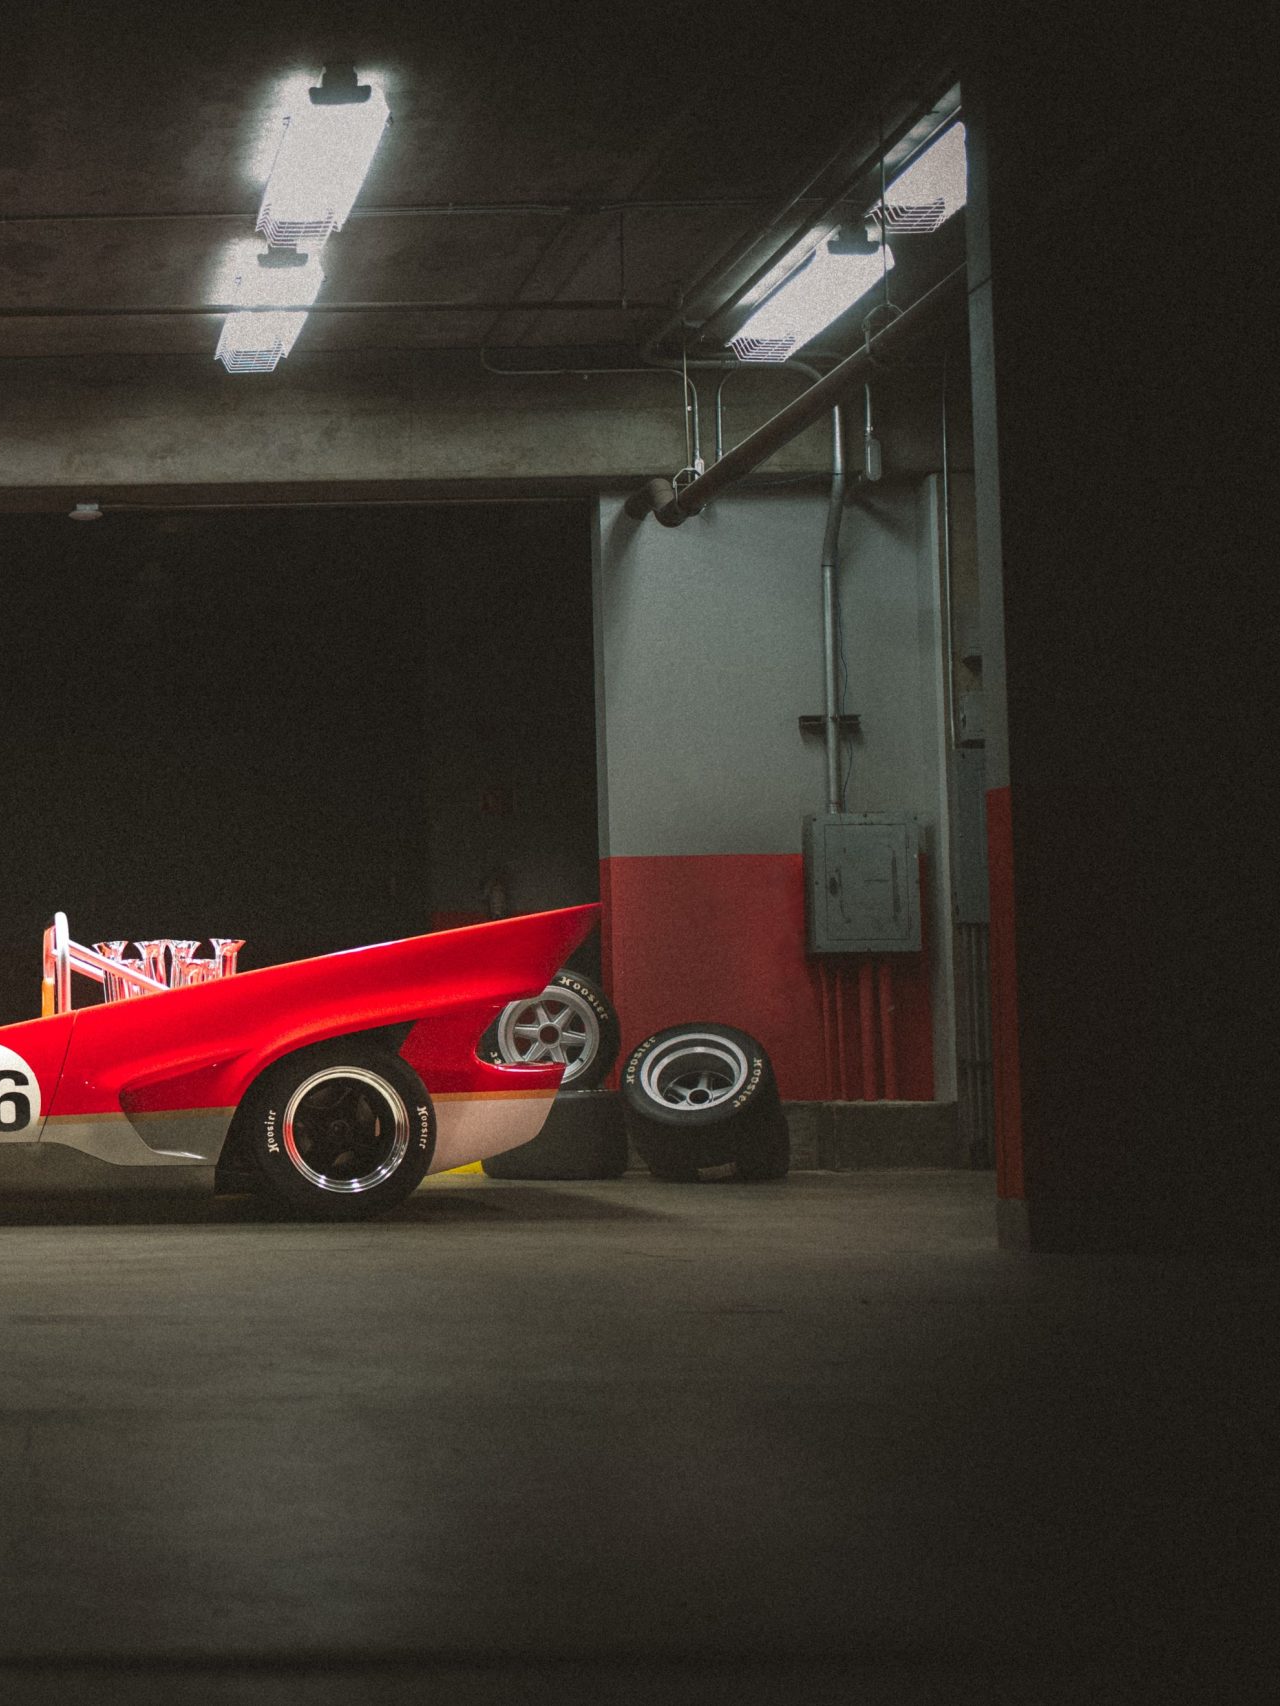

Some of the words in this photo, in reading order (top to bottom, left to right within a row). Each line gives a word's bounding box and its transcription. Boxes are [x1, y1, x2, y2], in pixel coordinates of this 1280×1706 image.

[558, 976, 608, 1020] Hoosier
[626, 1036, 656, 1084] Hoosier
[732, 1057, 762, 1107] Hoosier
[264, 1110, 280, 1152] Hoosier
[417, 1106, 428, 1149] Hoosier
